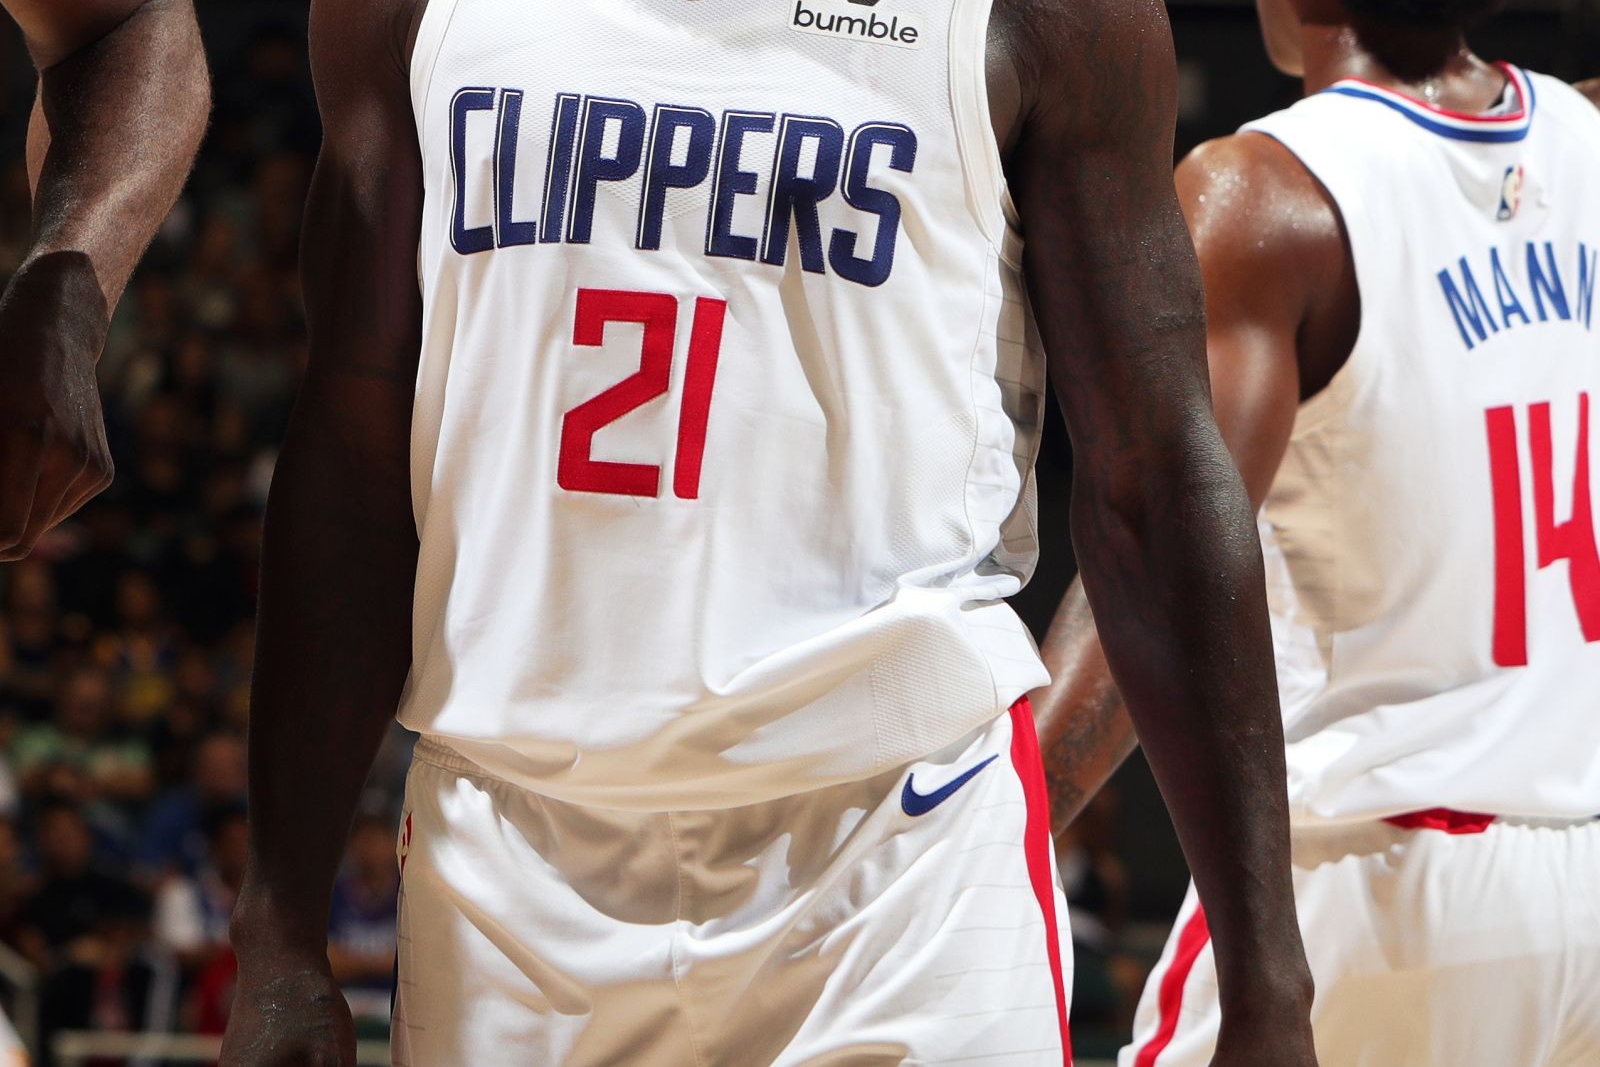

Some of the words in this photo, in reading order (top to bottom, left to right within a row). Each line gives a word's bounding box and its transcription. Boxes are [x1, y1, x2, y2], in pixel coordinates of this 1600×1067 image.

[793, 0, 919, 45] bumble
[449, 86, 918, 288] CLIPPERS
[556, 288, 727, 500] 21
[1485, 390, 1600, 668] 14
